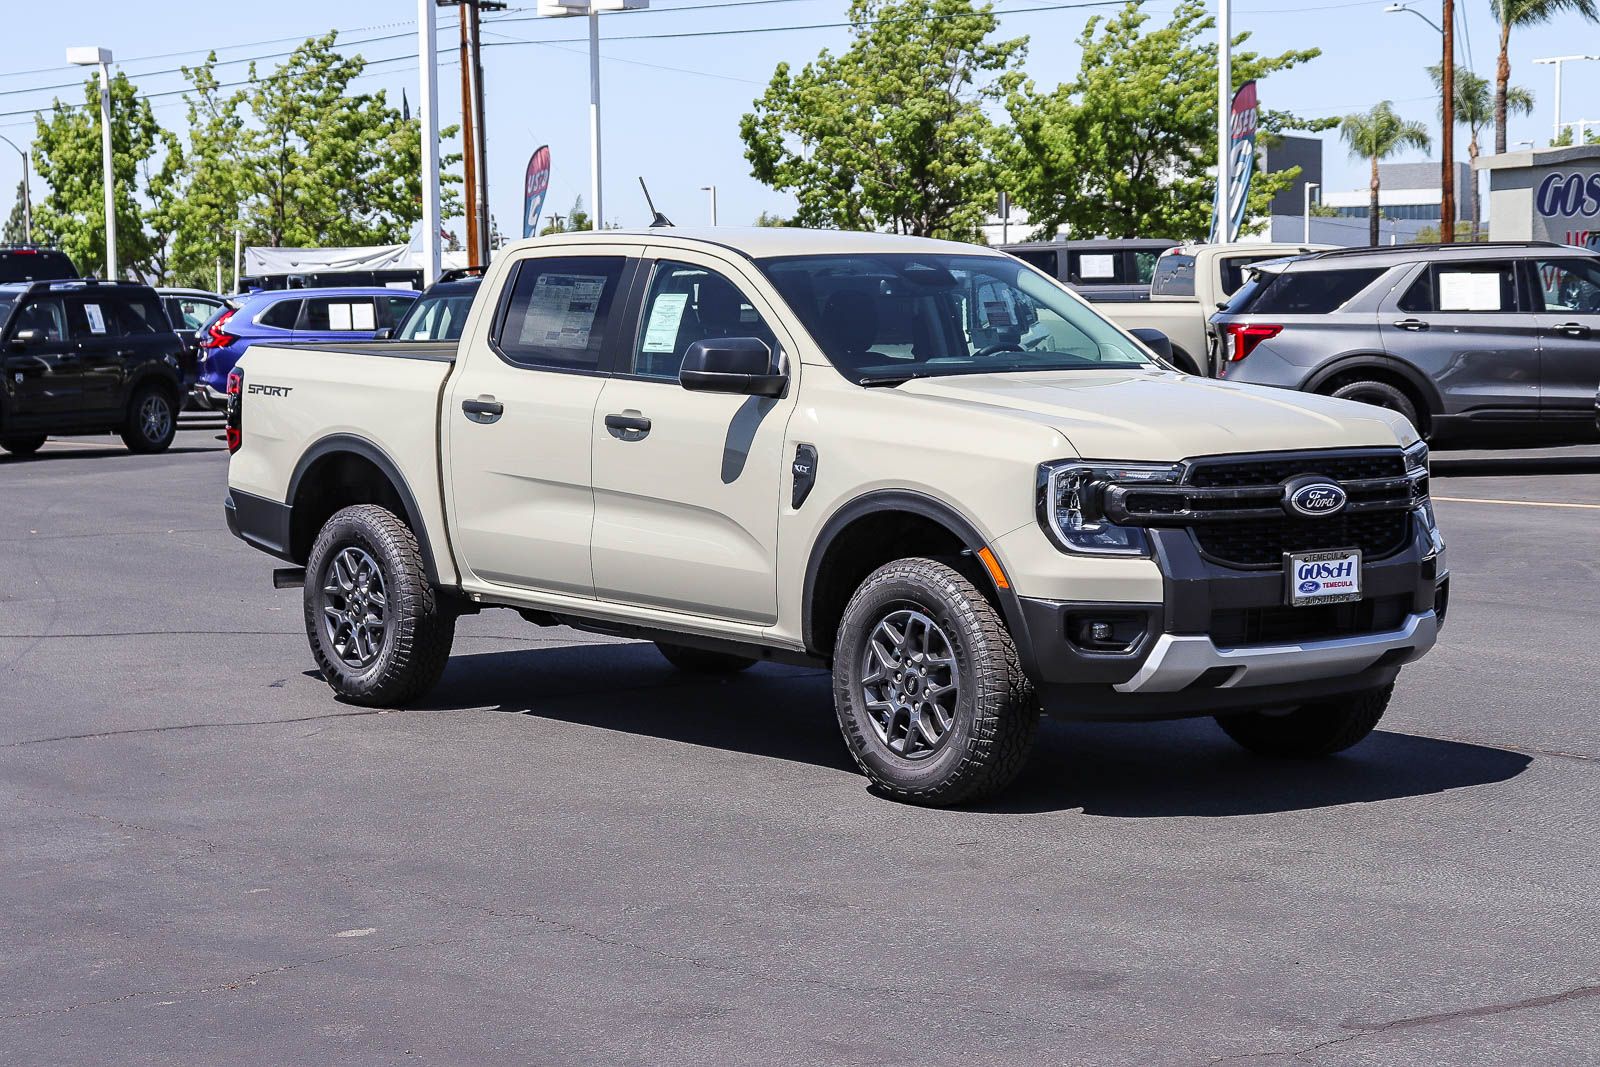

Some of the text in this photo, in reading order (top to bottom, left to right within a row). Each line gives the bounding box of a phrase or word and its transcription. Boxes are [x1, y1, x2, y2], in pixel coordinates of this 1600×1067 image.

[247, 383, 294, 398] SPORT
[794, 464, 810, 473] XLT
[1306, 490, 1336, 508] Ford
[1322, 580, 1354, 589] TEMECULA
